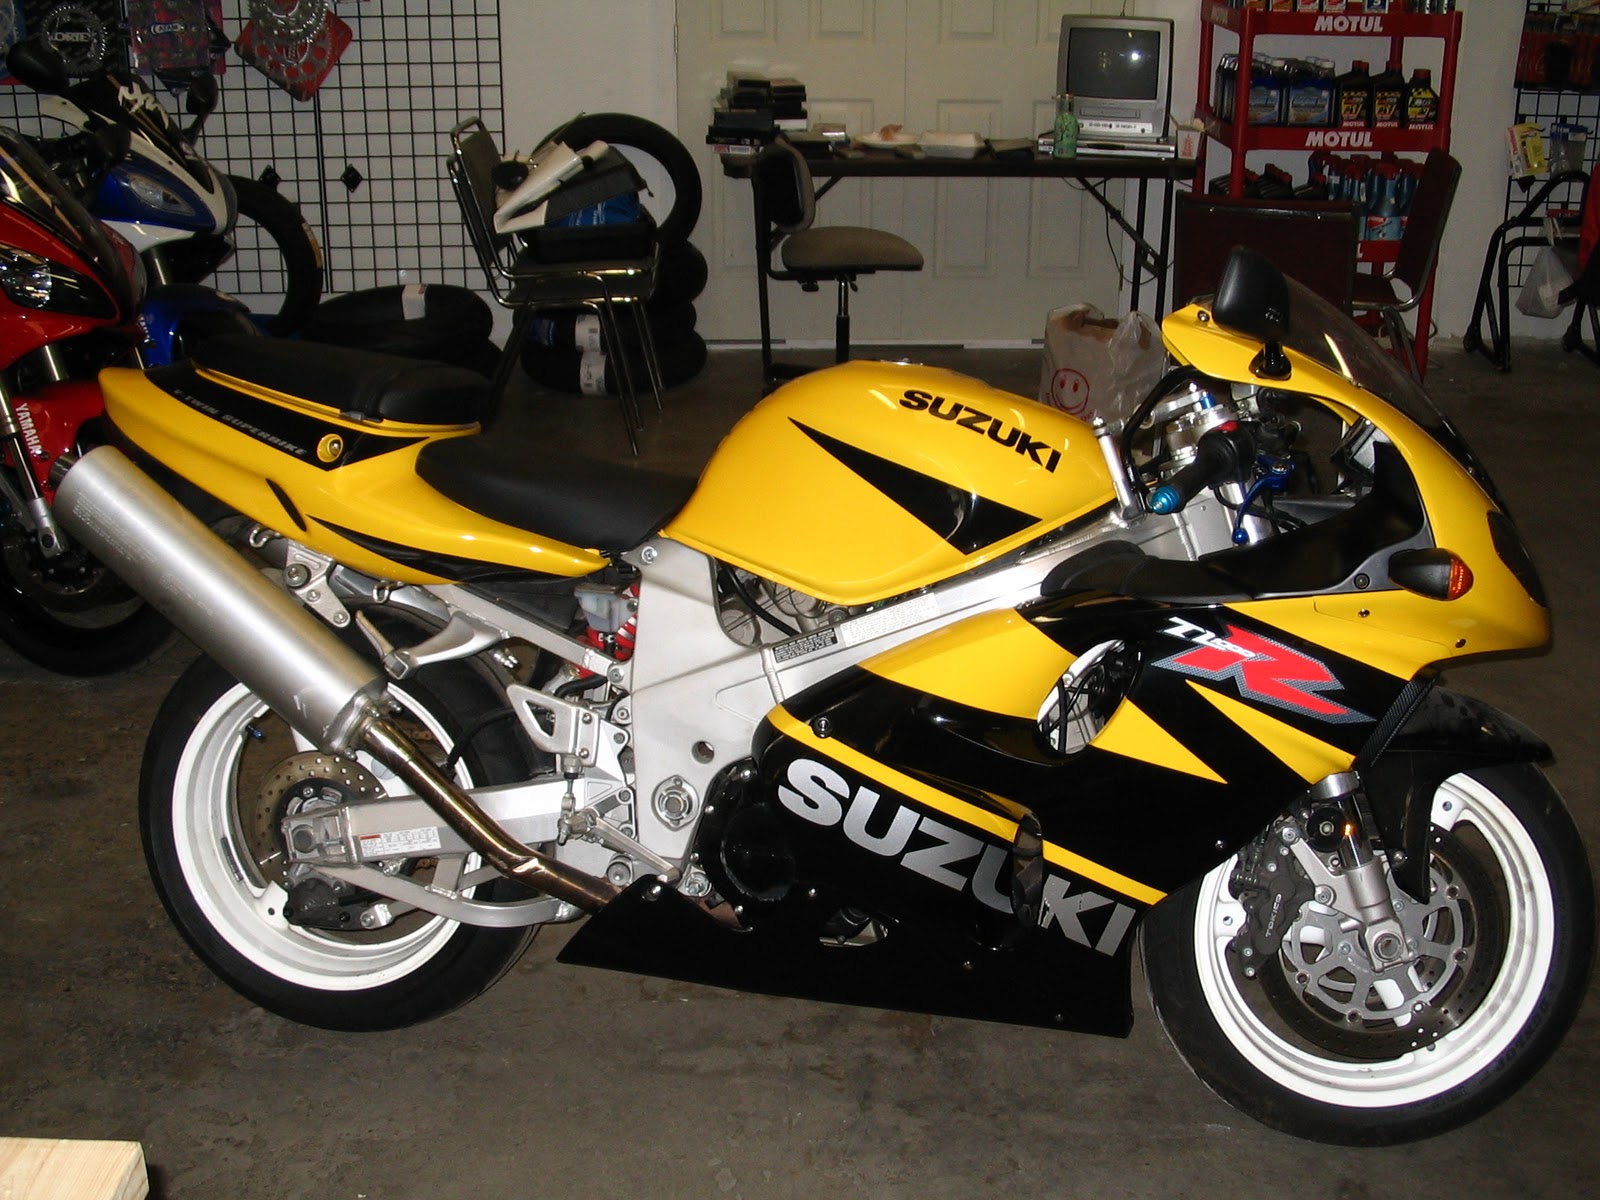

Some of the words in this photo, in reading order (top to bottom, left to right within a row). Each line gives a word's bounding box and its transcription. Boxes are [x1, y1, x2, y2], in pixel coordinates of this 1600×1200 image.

[1314, 15, 1383, 32] MOTUL
[1305, 131, 1373, 147] MOTUL
[15, 402, 43, 455] YAMAHA
[222, 414, 307, 455] SUPERBIKE
[899, 389, 1062, 473] SUZUKI
[778, 758, 1136, 957] SUZUKI
[1265, 893, 1283, 938] TOKICO
